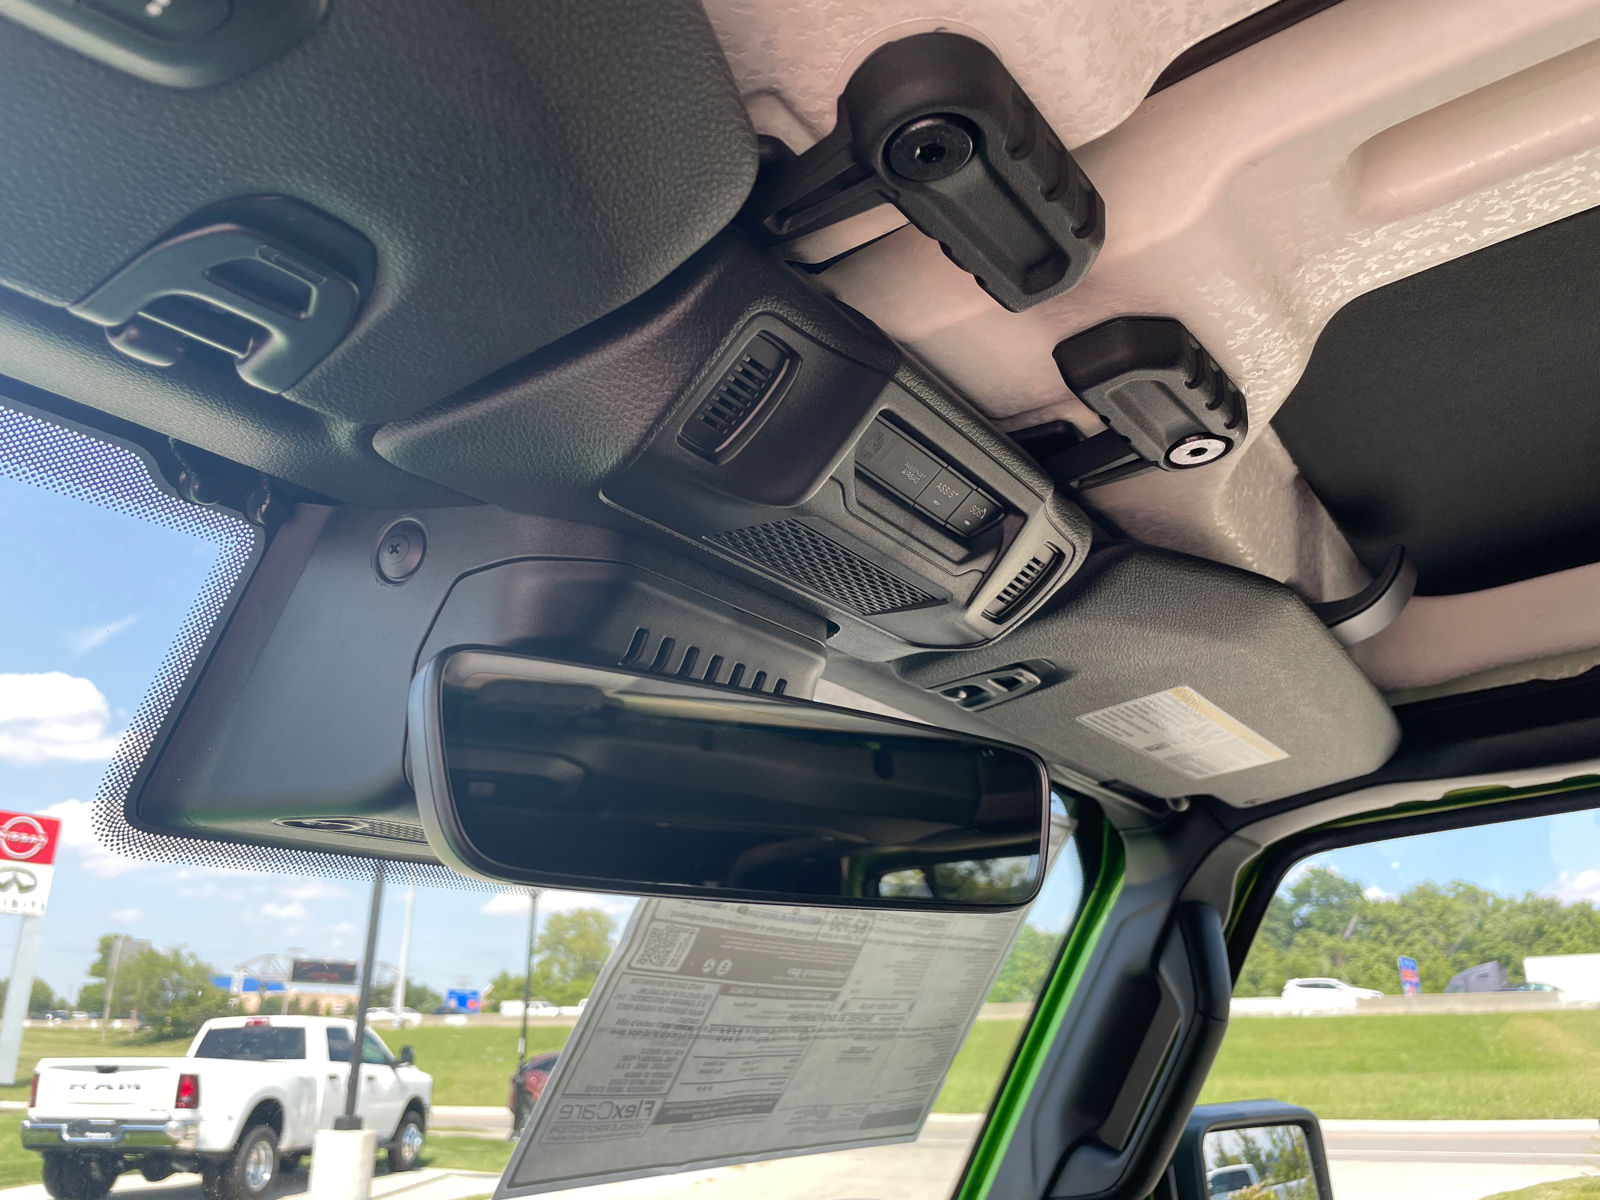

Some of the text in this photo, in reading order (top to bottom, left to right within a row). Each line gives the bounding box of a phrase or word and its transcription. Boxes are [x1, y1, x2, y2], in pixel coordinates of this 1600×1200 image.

[860, 450, 875, 461] OFF
[901, 469, 921, 485] AIRBAG
[934, 482, 960, 500] ASSIST
[969, 504, 984, 518] SOS
[0, 831, 48, 846] ISSAN
